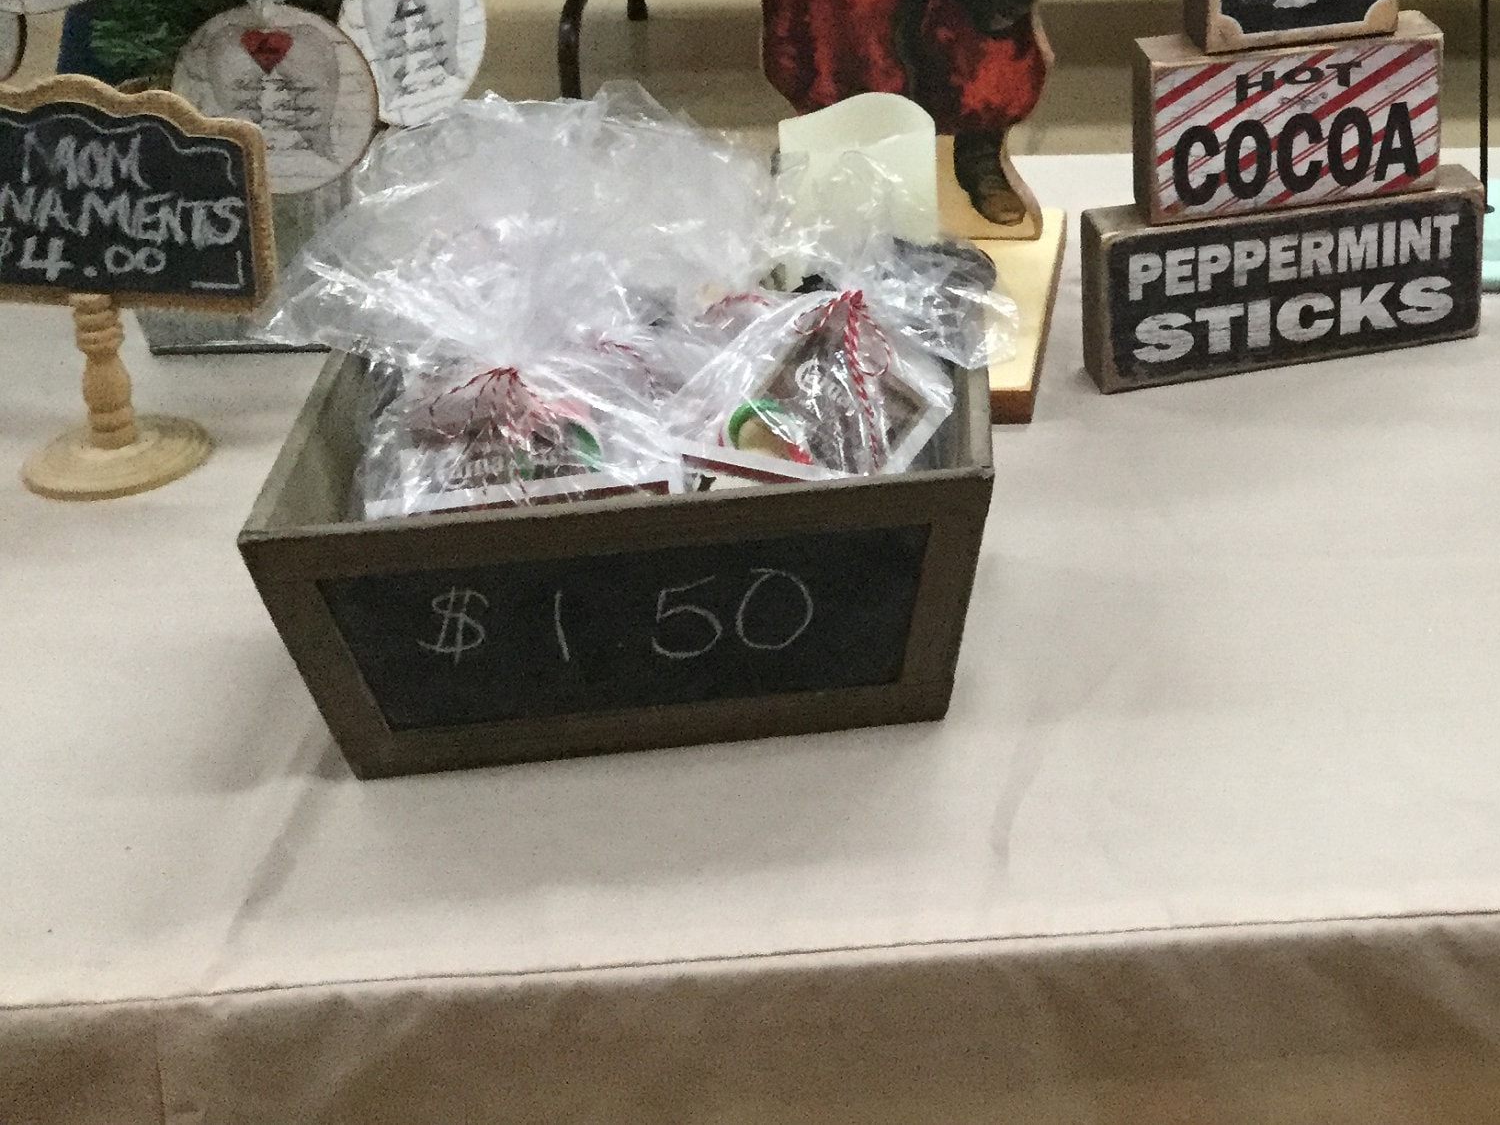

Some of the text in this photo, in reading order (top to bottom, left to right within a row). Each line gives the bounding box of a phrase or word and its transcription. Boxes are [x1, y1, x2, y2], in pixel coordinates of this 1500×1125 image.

[1235, 59, 1363, 106] HOT
[21, 130, 151, 191] MOM
[1172, 102, 1421, 207] COCOA
[1128, 213, 1460, 302] PEPPERMINT
[1132, 275, 1455, 365] STICKS
